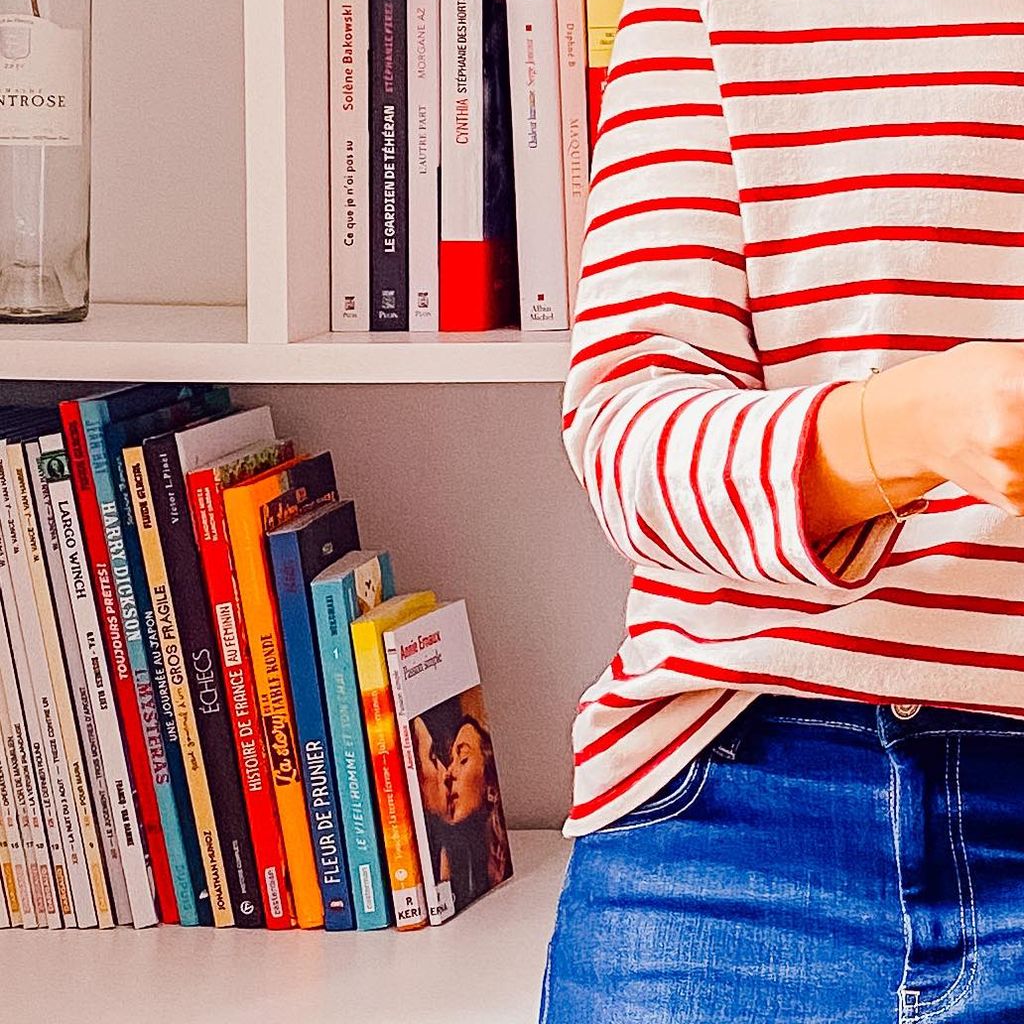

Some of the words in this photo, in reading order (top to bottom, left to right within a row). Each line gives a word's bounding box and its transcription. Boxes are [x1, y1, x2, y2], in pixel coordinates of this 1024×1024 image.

[342, 5, 352, 63] Bakowski
[417, 8, 425, 21] AZ
[457, 26, 466, 43] DES
[418, 25, 426, 79] MORGANE
[456, 45, 466, 93] STÉPHANIE
[342, 69, 353, 110] Solène
[382, 106, 395, 161] TÉHÉRAN
[456, 99, 468, 144] CYNTHIA
[345, 155, 355, 172] pas
[346, 141, 353, 151] su
[385, 163, 395, 179] DE
[346, 211, 355, 228] que
[385, 182, 395, 236] GARDIEN
[344, 233, 354, 246] Ce
[385, 238, 395, 252] LE
[167, 492, 180, 524] Victor
[58, 500, 77, 548] LARGO
[68, 552, 86, 599] WINCH
[100, 500, 126, 560] HARRY
[113, 566, 142, 642] DICKSON
[144, 611, 159, 649] JAPON
[152, 585, 176, 640] FRAGILE
[107, 616, 128, 680] TOUJOURS
[151, 650, 162, 666] AU
[163, 644, 184, 685] GROS
[226, 648, 238, 662] AU
[153, 668, 173, 719] JOURNÉE
[191, 648, 220, 714] ÉCHECS
[229, 670, 249, 717] FRANCE
[266, 676, 284, 712] TABLE
[136, 682, 170, 785] MYSTERAS
[166, 722, 178, 741] UNE
[237, 720, 252, 737] DE
[266, 712, 295, 758] story
[240, 740, 262, 792] HISTOIRE
[274, 757, 297, 784] La
[306, 740, 329, 807] PRUNIER
[343, 751, 360, 800] HOMME
[64, 815, 73, 832] NUIT
[315, 811, 332, 829] DE
[350, 802, 365, 835] VIEIL
[318, 833, 339, 884] FLEUR
[356, 837, 368, 851] LE
[209, 863, 225, 910] JONATHAN
